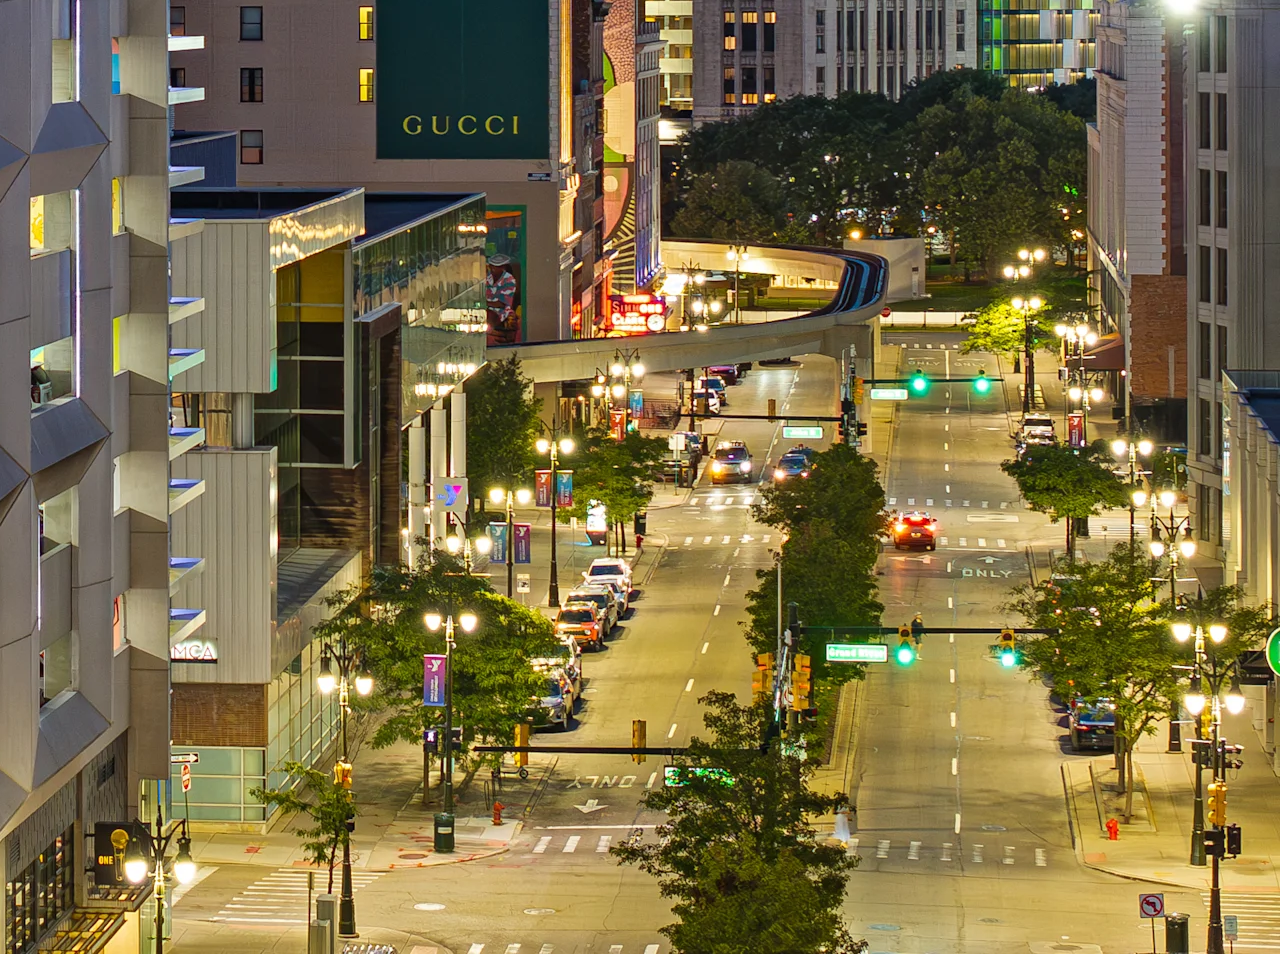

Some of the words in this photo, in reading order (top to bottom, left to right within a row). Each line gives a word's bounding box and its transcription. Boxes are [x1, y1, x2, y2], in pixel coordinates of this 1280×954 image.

[402, 115, 519, 135] GUCCI
[962, 567, 1012, 578] ONLY
[566, 774, 637, 788] ONLY
[98, 856, 114, 865] ONE
